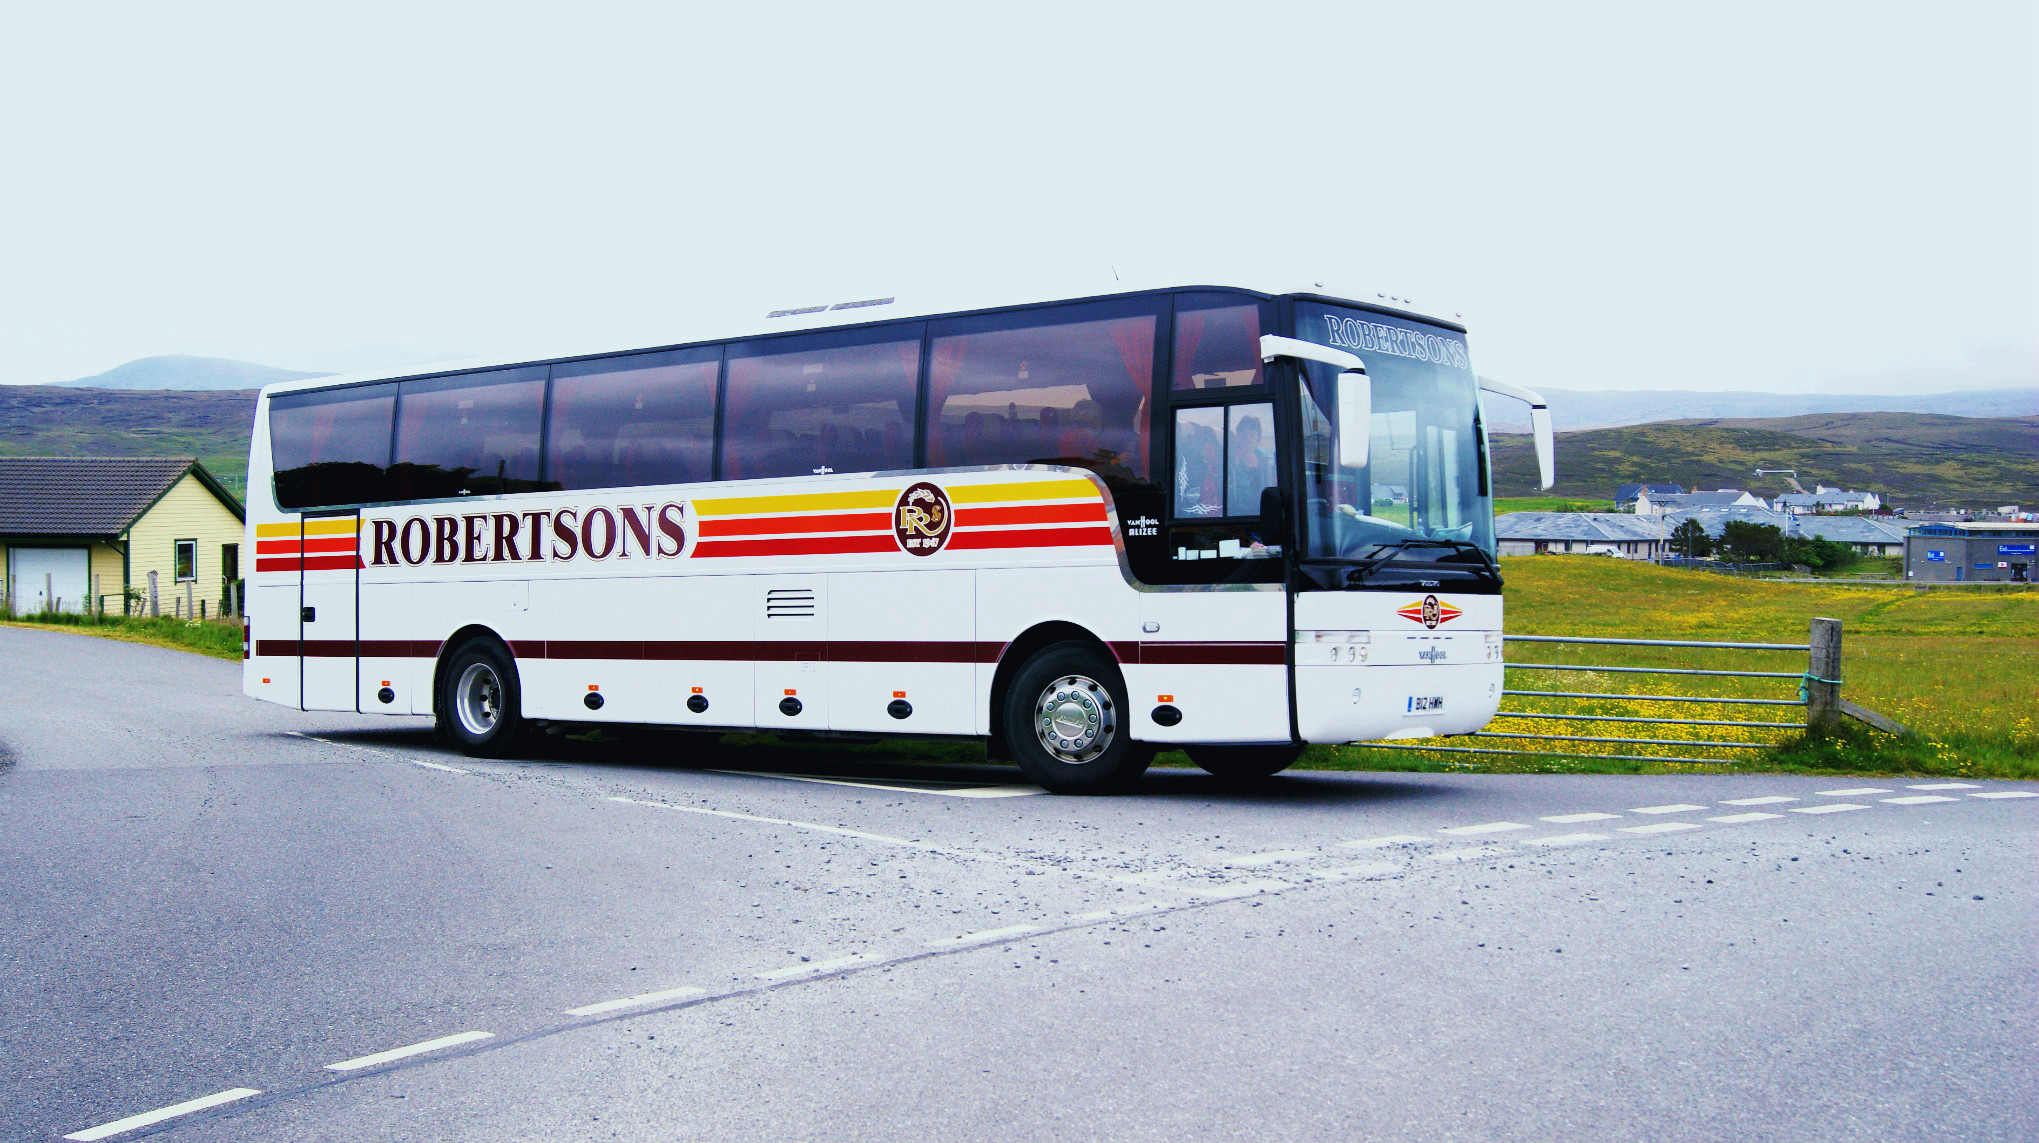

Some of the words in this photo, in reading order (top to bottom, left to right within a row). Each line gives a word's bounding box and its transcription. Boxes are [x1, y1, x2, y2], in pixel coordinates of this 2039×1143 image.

[1324, 315, 1468, 369] ROBERTSONS
[369, 500, 687, 567] ROBERTSONS
[1128, 527, 1158, 536] ALIZEE
